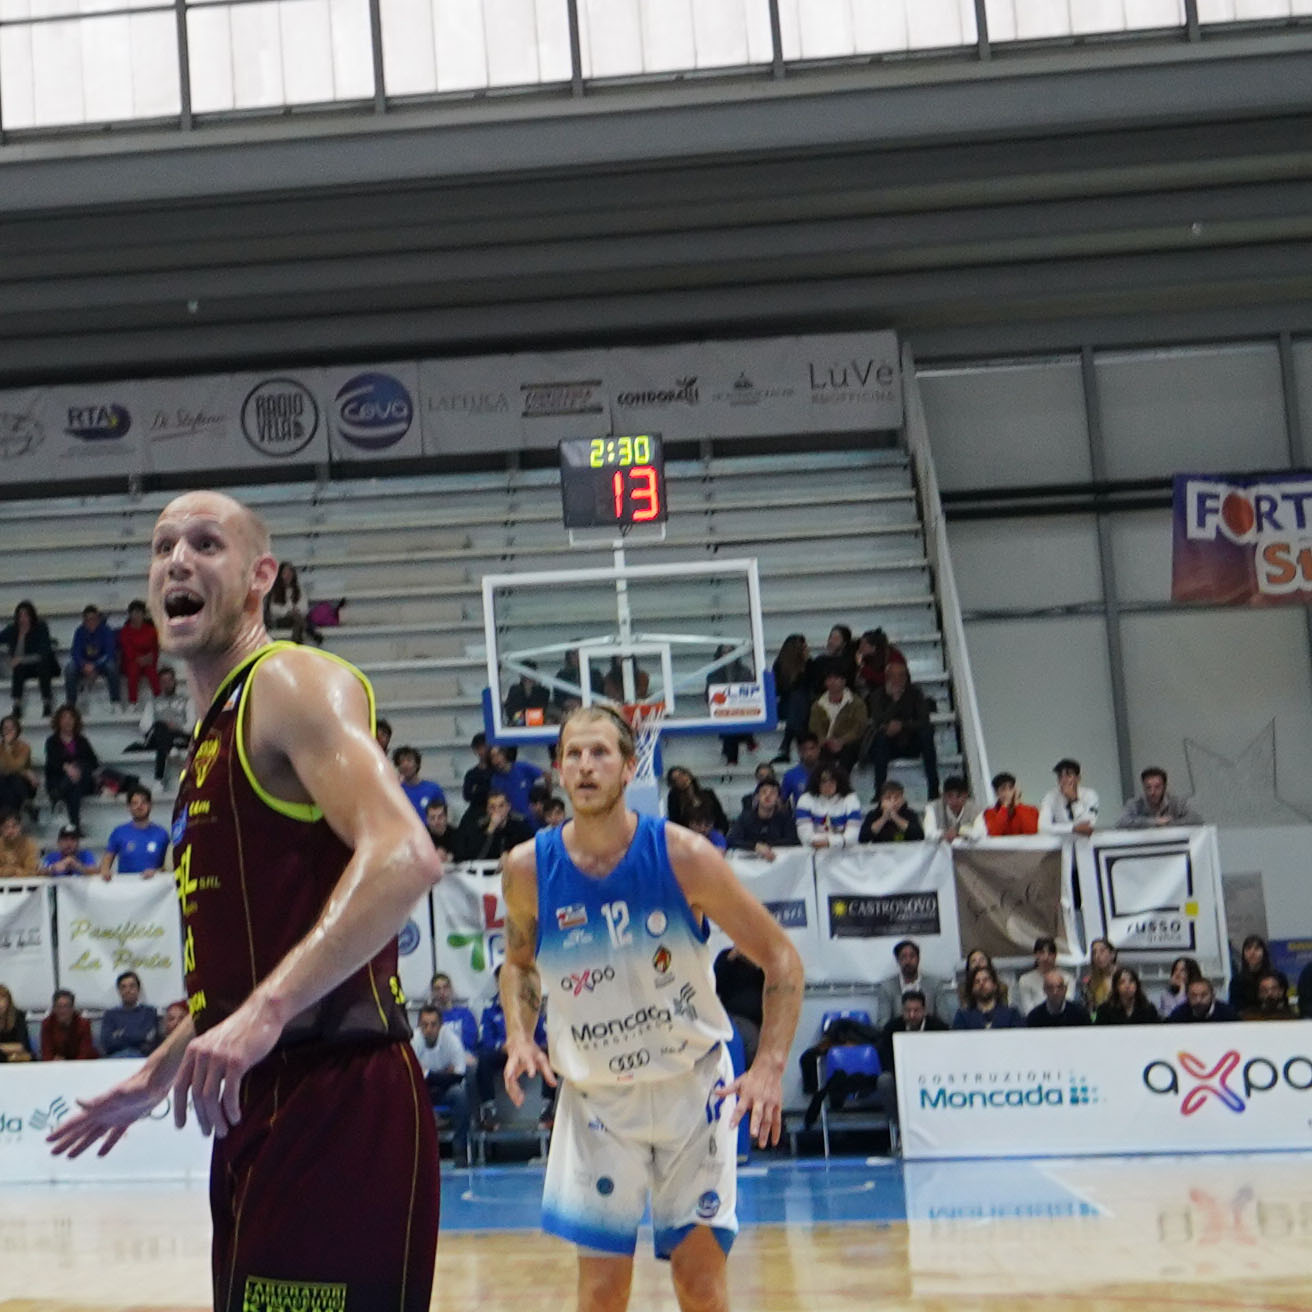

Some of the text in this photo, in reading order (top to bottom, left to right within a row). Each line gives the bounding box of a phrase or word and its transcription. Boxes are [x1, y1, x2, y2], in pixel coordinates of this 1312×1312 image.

[255, 392, 304, 418] RADIO
[589, 435, 650, 468] 2:30
[611, 465, 660, 522] 13
[600, 900, 633, 948] 12
[919, 1085, 1065, 1110] Moncada
[1142, 1049, 1312, 1116] axpo
